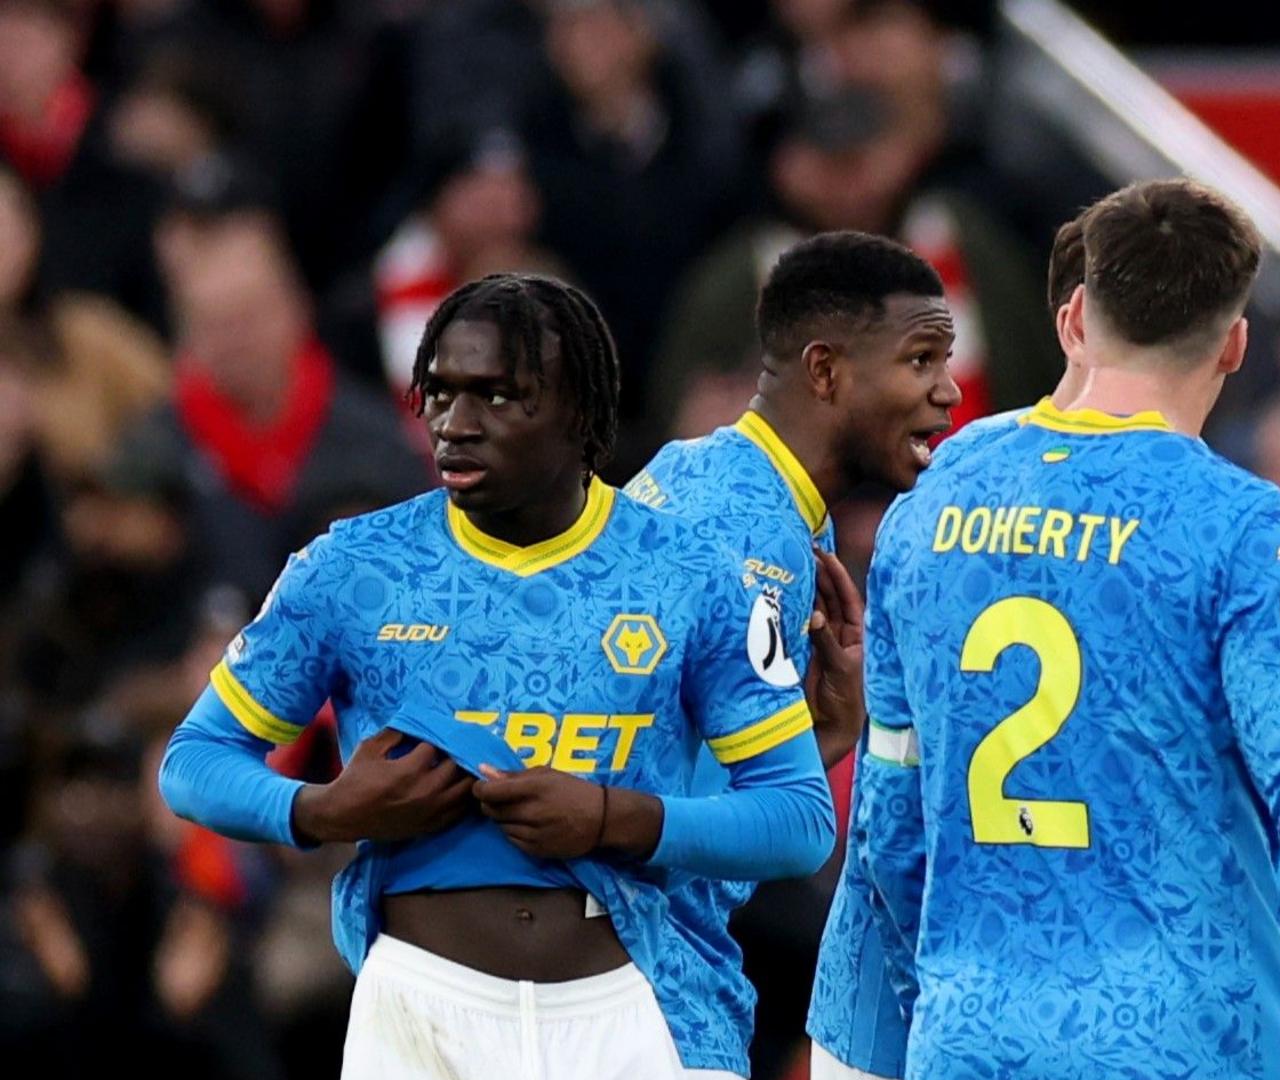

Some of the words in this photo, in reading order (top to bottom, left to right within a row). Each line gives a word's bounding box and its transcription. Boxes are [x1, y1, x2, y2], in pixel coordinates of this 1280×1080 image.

[932, 505, 1140, 565] DOHERTY
[744, 557, 796, 584] SUDU
[376, 622, 449, 642] SUDU
[959, 595, 1091, 849] 2
